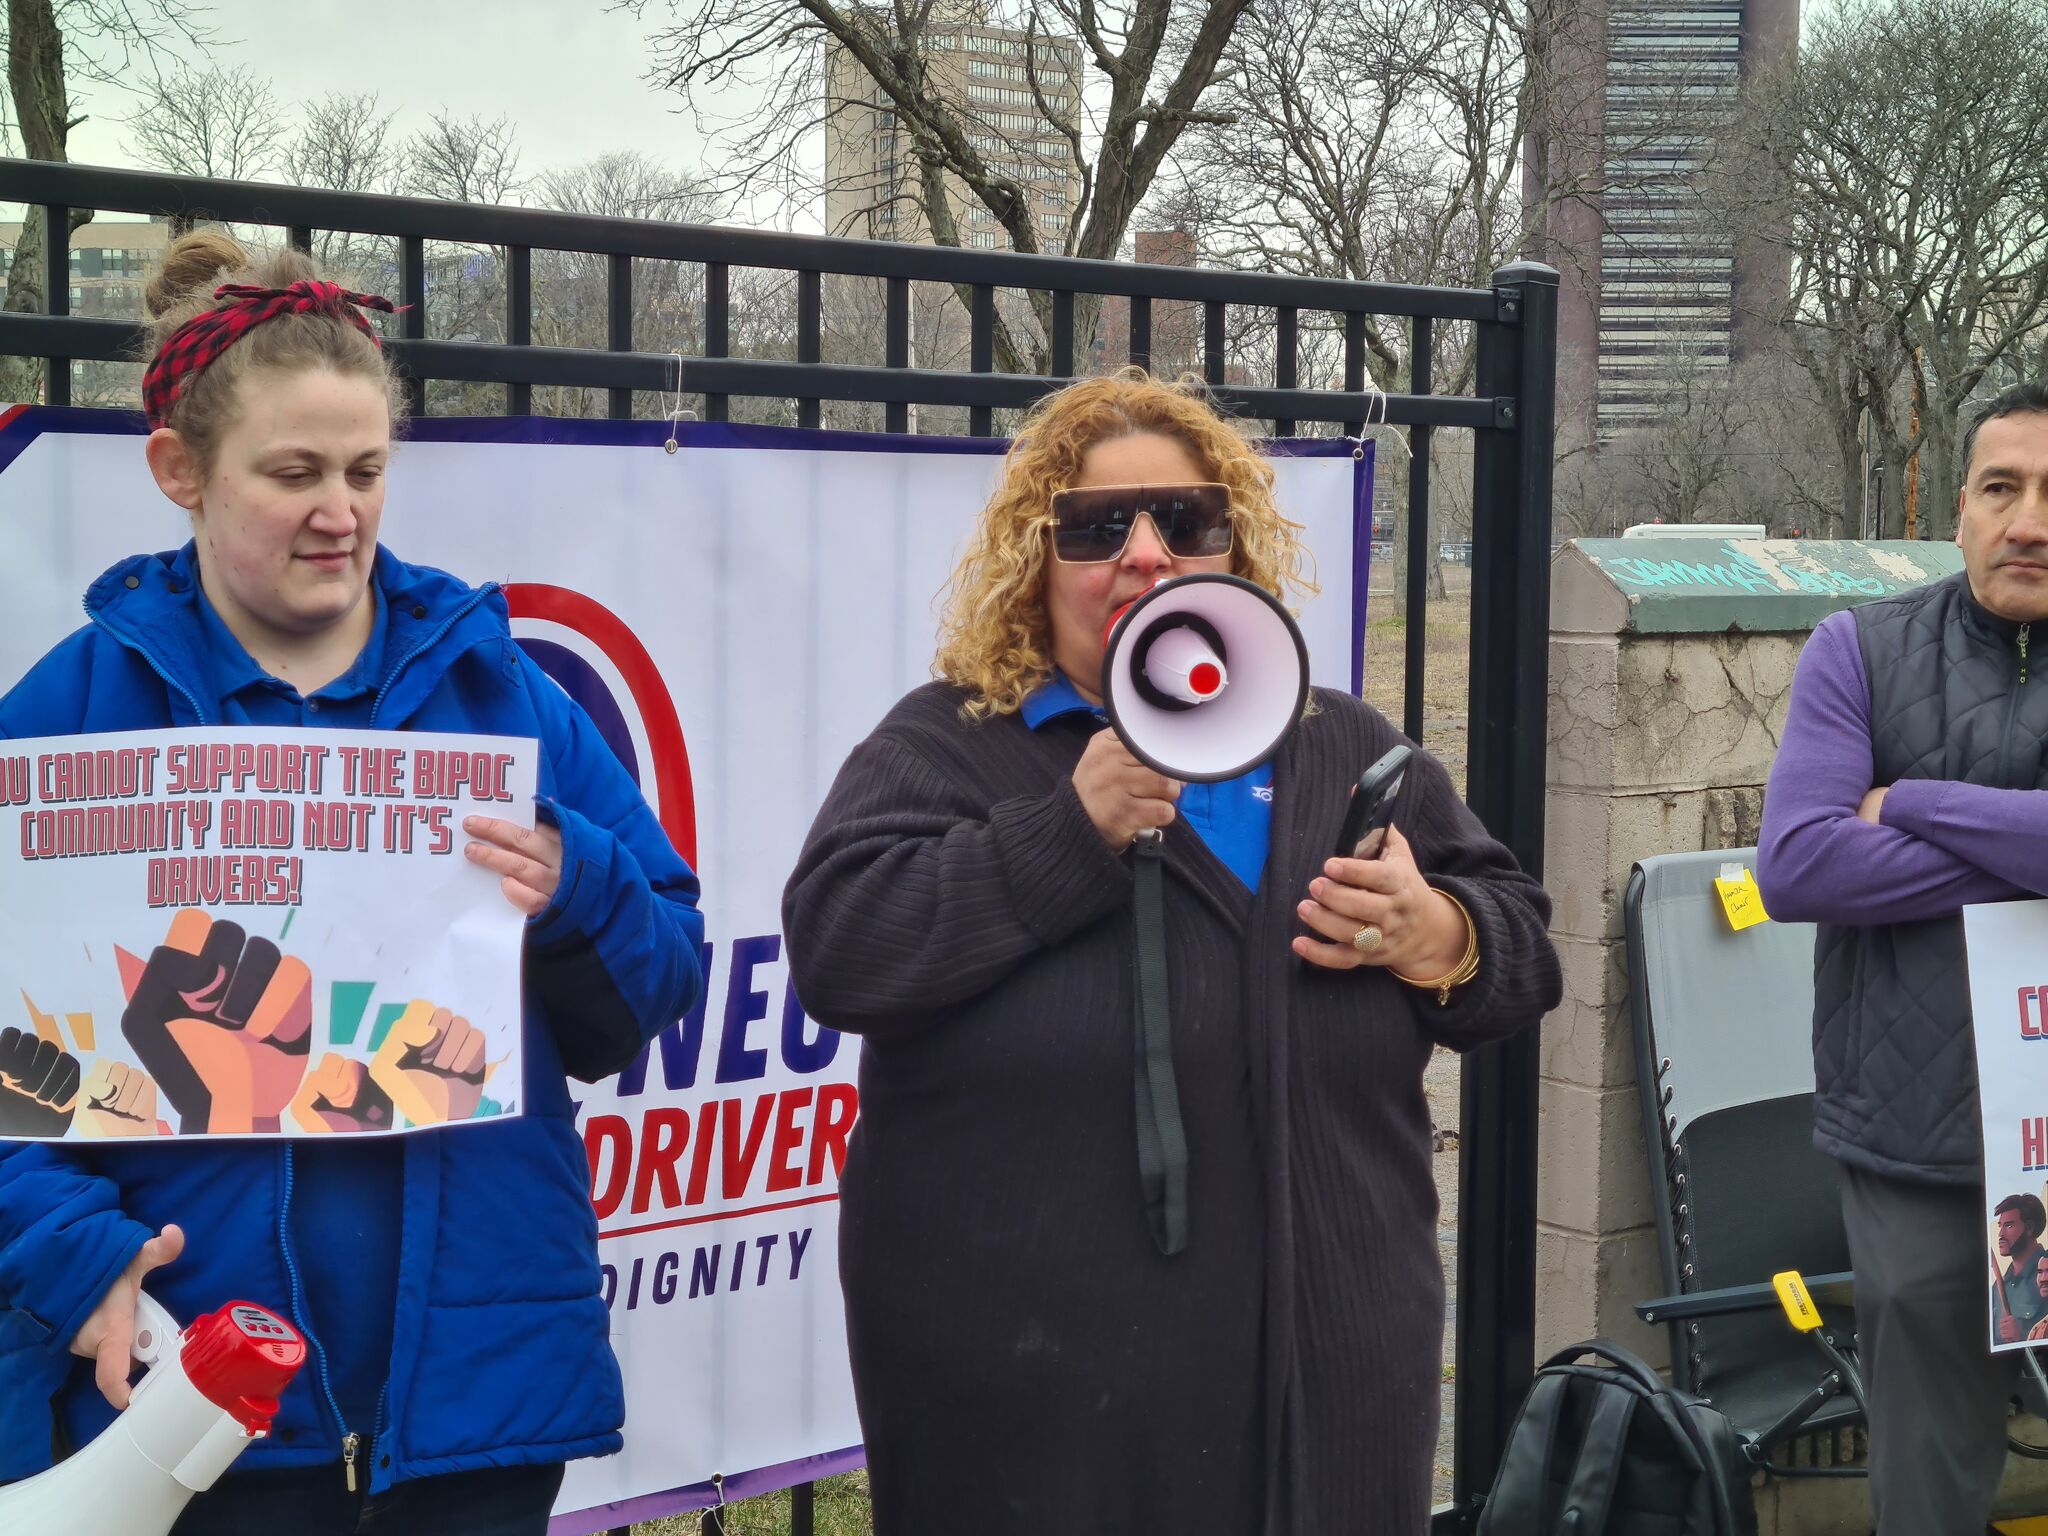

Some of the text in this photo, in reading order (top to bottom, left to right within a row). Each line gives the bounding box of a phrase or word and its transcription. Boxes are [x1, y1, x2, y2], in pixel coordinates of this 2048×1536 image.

[38, 746, 159, 803] CANNOT
[166, 743, 327, 795] SUPPORT
[337, 746, 405, 797] THE
[413, 752, 515, 802] BIPOC
[20, 799, 452, 860] COMMUNITY AND NOT IT'S
[147, 855, 303, 908] DRIVERS!
